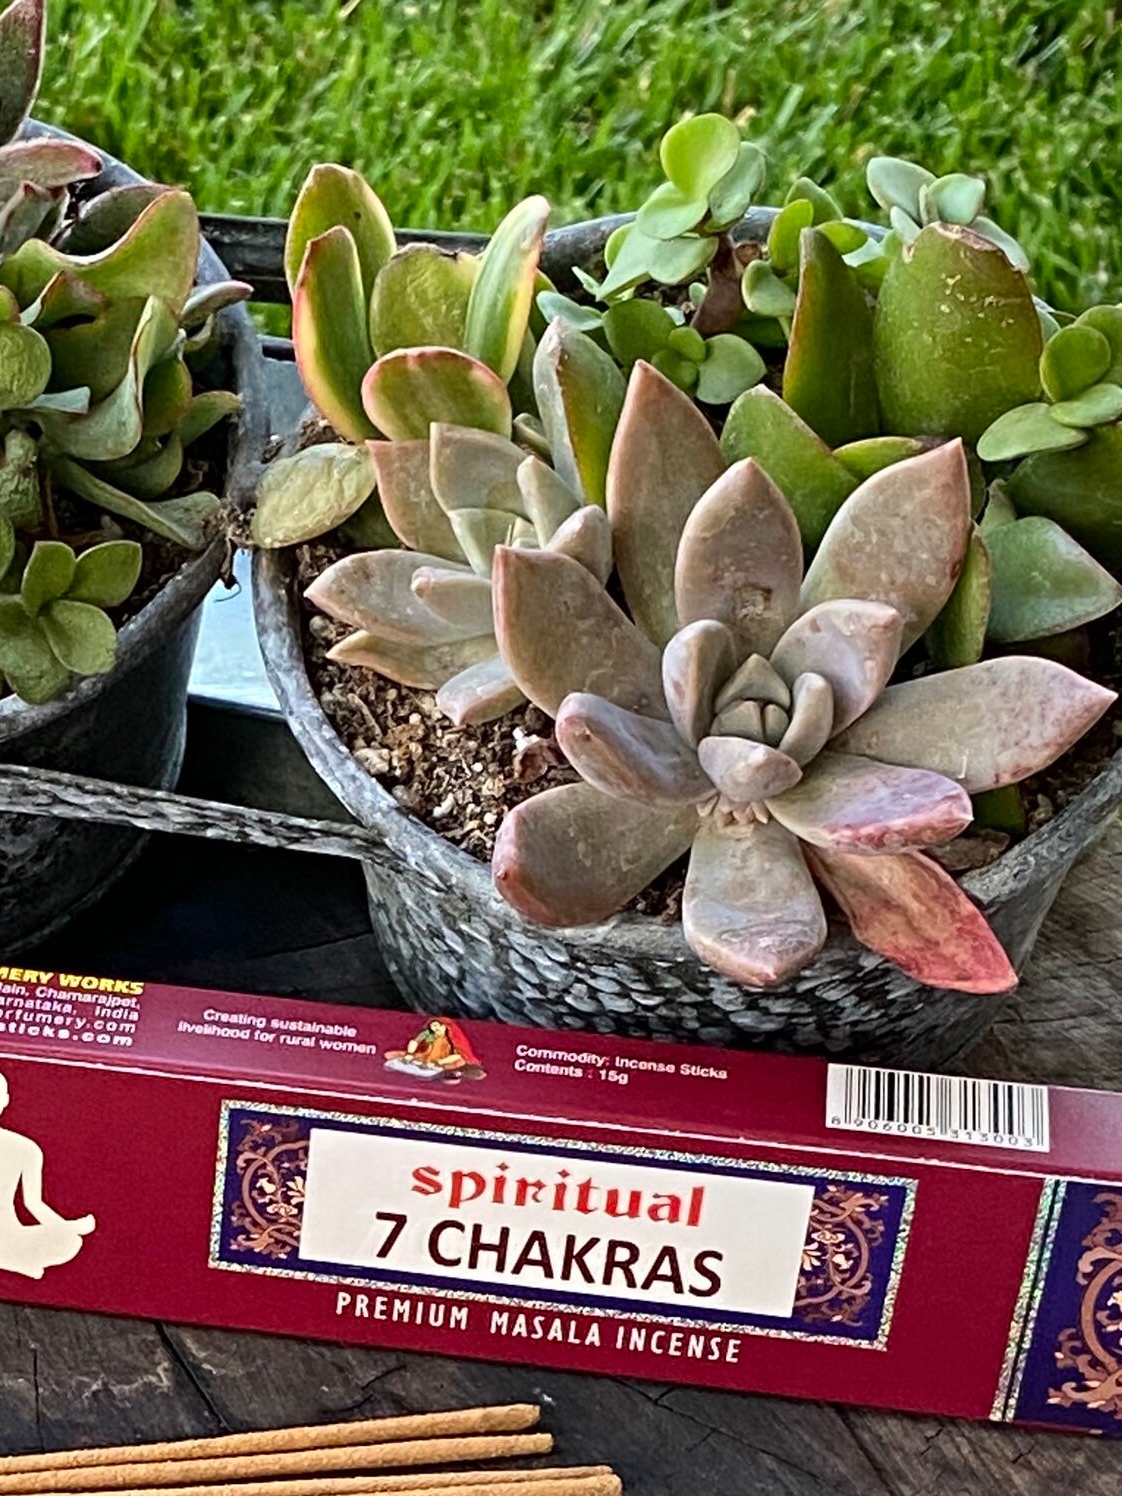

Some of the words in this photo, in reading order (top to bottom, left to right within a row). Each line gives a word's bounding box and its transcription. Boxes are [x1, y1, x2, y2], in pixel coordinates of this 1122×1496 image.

[59, 973, 145, 995] WORKS
[95, 1006, 139, 1021] India
[203, 1008, 266, 1028] Creating
[270, 1018, 357, 1038] sustainable
[178, 1020, 250, 1039] livelihood
[254, 1030, 276, 1043] for
[280, 1034, 315, 1048] rural
[319, 1040, 377, 1055] women
[514, 1059, 584, 1078] Contents
[599, 1069, 629, 1085] 15g
[615, 1056, 676, 1073] Incense
[680, 1063, 728, 1080] Sticks
[410, 1161, 706, 1228] spiritual
[374, 1211, 407, 1259] 7
[427, 1219, 724, 1298] CHAKRAS
[336, 1292, 468, 1331] PREMIUM
[490, 1312, 601, 1348] MASALA
[615, 1325, 742, 1364] INCENSE
